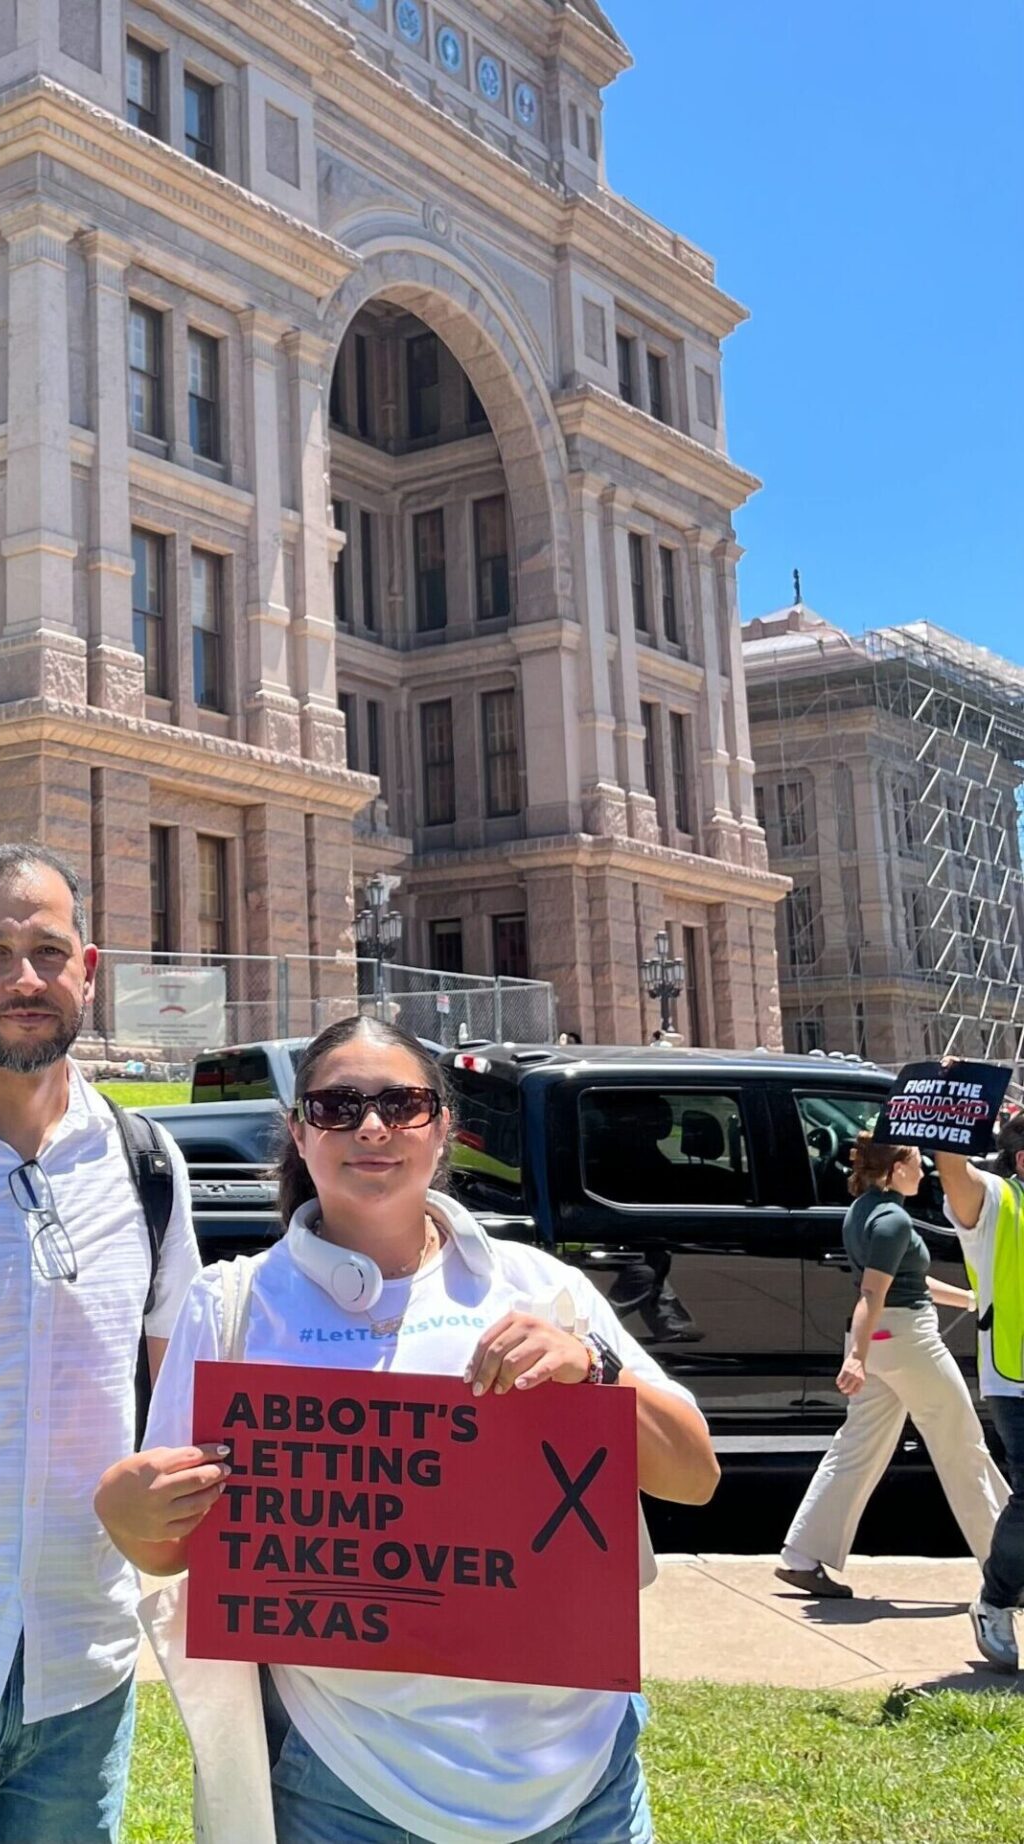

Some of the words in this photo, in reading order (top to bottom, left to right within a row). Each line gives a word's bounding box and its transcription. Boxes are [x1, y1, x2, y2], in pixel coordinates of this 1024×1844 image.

[888, 1095, 990, 1126] TRUMP
[903, 1079, 947, 1094] FIGHT
[947, 1080, 983, 1099] THE
[889, 1121, 972, 1145] TAKEOVER
[221, 1391, 479, 1443] ABBOTT'S
[223, 1438, 442, 1487] LETTING
[222, 1484, 404, 1531] TRUMP
[219, 1531, 360, 1578] TAKE
[372, 1540, 518, 1589] OVER
[217, 1593, 391, 1644] TEXAS
